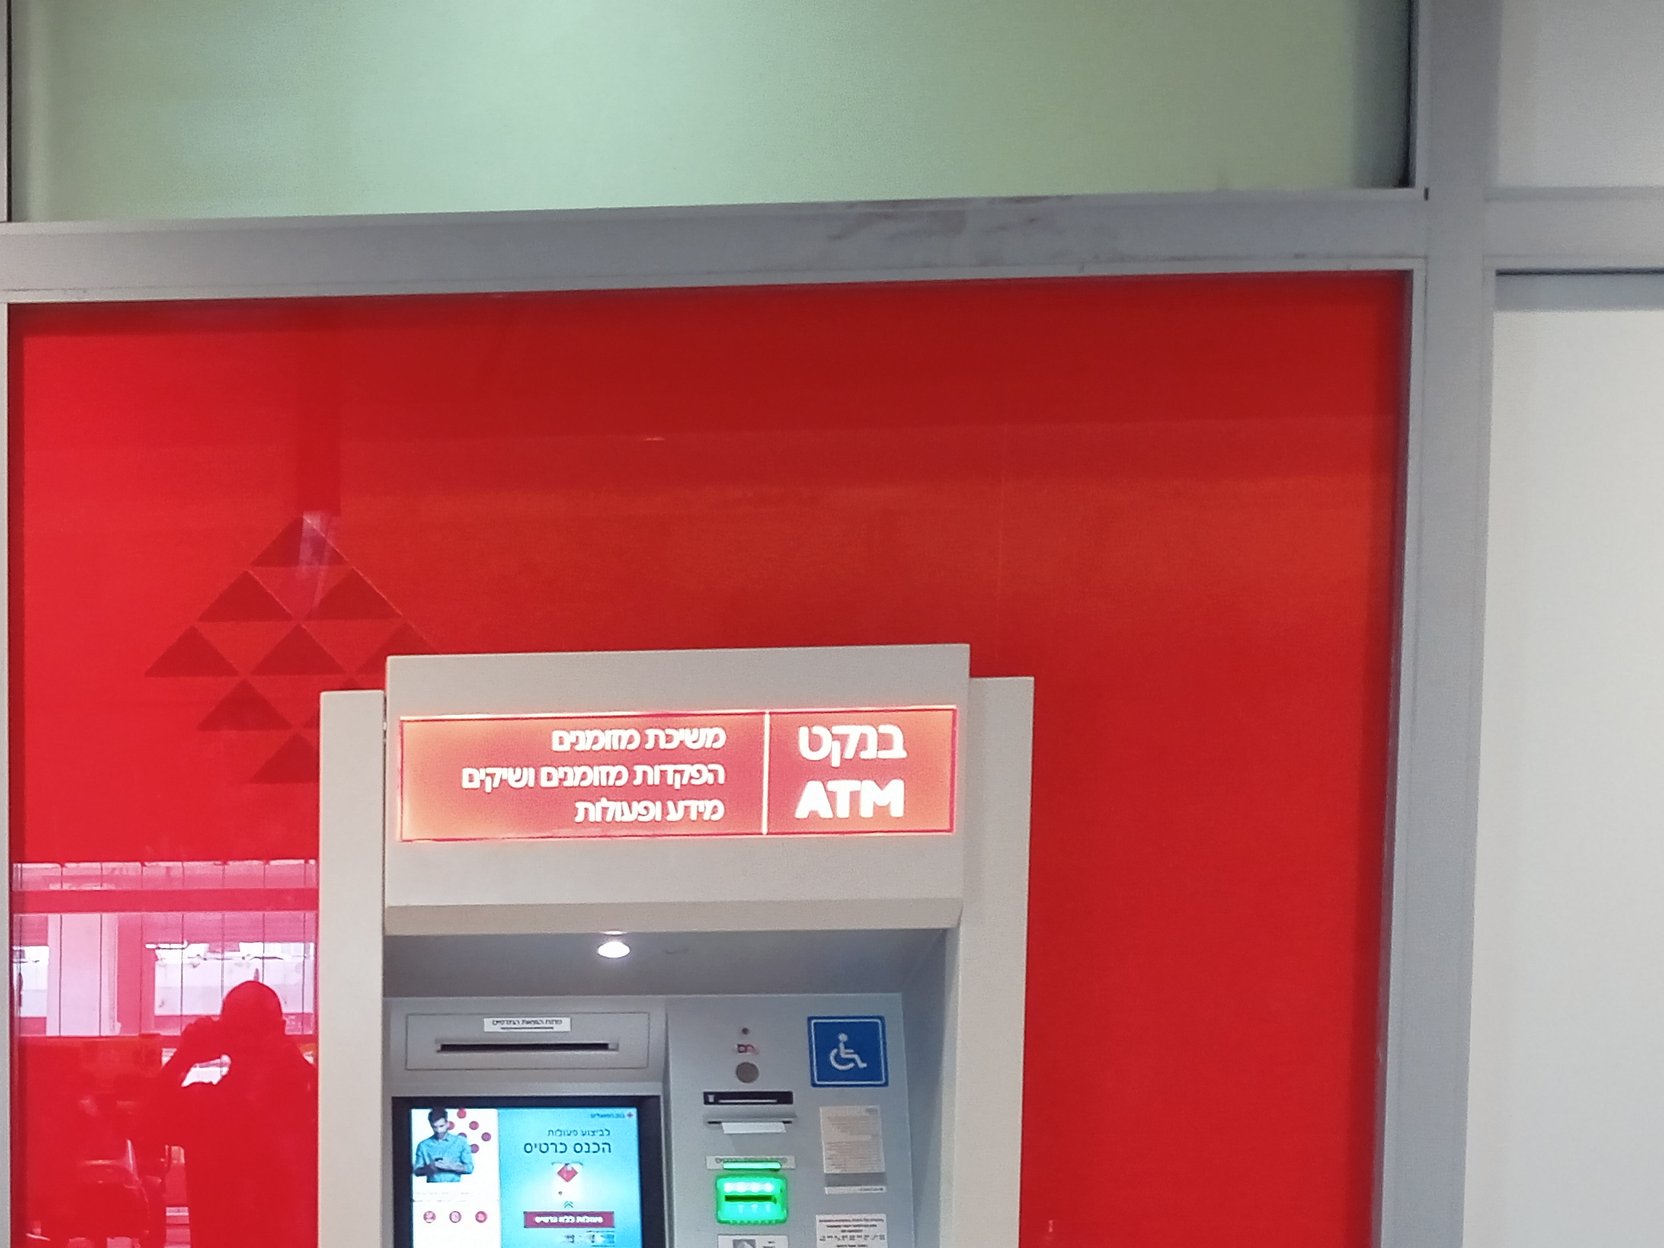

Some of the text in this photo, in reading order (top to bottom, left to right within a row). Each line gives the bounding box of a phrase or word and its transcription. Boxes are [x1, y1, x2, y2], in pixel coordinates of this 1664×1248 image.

[551, 726, 727, 752] משיכת מזומנים
[797, 724, 908, 768] בנקט
[461, 763, 725, 793] הפקדות מזומנים ושיקים
[574, 796, 725, 823] מידע ופעולות
[794, 778, 905, 819] ATM
[547, 1128, 611, 1137] לביצוע פעולות
[523, 1142, 612, 1154] הכנס כרטיס
